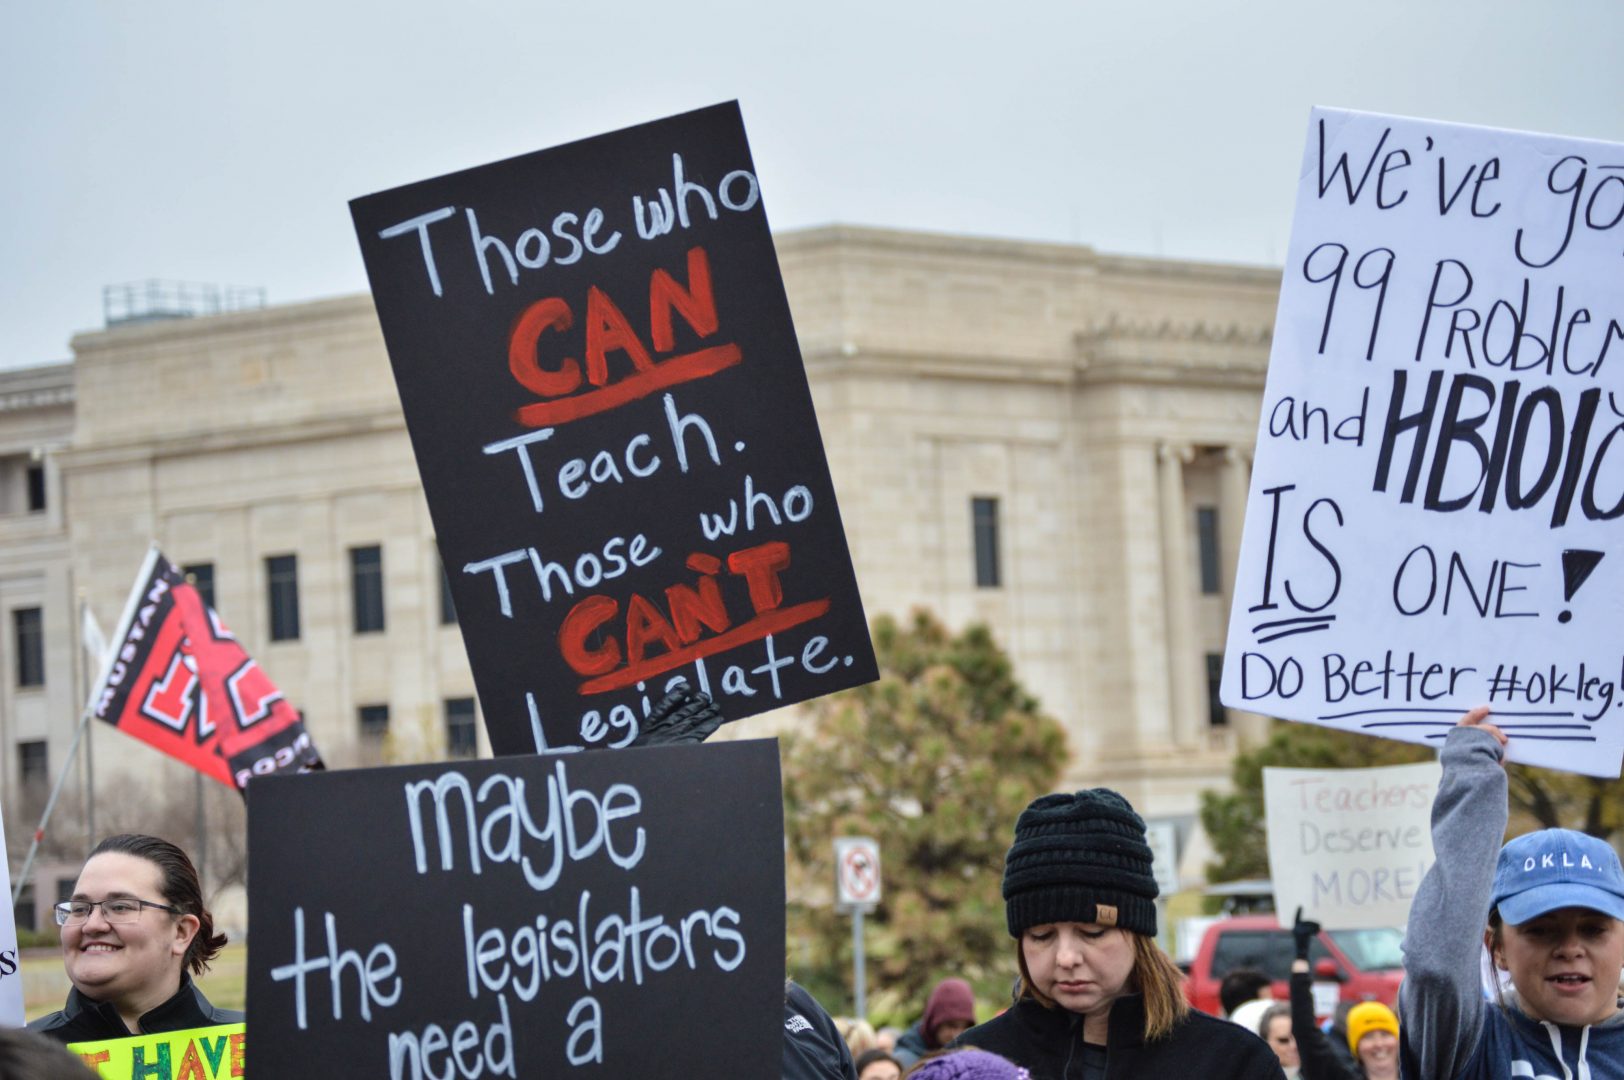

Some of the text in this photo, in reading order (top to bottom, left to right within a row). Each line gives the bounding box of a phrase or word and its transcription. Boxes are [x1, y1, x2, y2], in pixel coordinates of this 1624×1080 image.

[379, 152, 759, 297] Those who
[1318, 118, 1624, 268] We've go
[508, 247, 719, 397] CAN
[1303, 243, 1396, 361] 99
[482, 392, 746, 513] Teach.
[1269, 386, 1370, 447] and
[463, 474, 814, 618] Those who
[558, 541, 791, 677] CAN'T
[1248, 484, 1606, 624] IS ONE!
[95, 571, 169, 717] MUSTAN
[1322, 650, 1477, 703] Better
[404, 759, 647, 891] maybe
[1290, 777, 1430, 813] Teachers
[1299, 820, 1422, 855] Deserve
[1523, 851, 1603, 872] OKLA.
[270, 880, 747, 1030] the legislators
[388, 993, 603, 1080] need a
